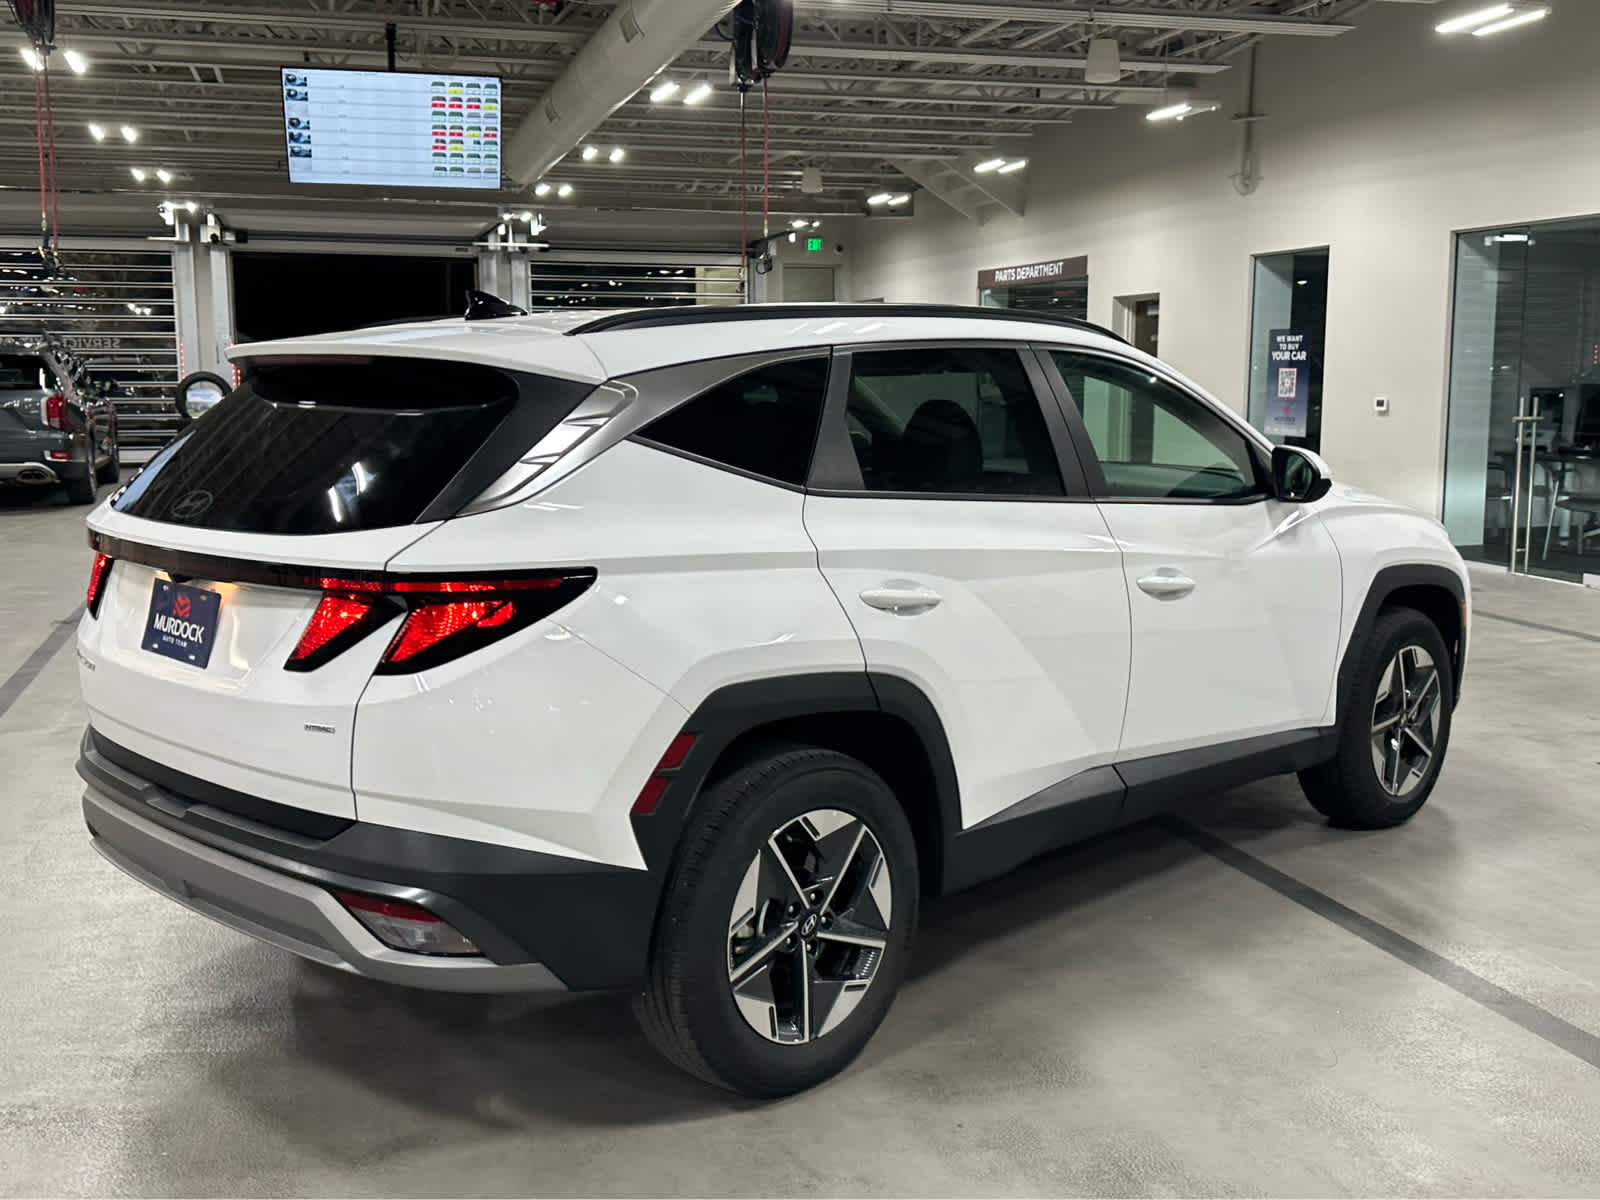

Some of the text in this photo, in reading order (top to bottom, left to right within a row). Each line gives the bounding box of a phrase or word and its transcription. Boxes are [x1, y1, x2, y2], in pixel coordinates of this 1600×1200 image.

[994, 262, 1063, 282] PARTS DEPARTMENT
[1272, 351, 1307, 360] YOUR CAR
[153, 612, 204, 644] MURDOCK
